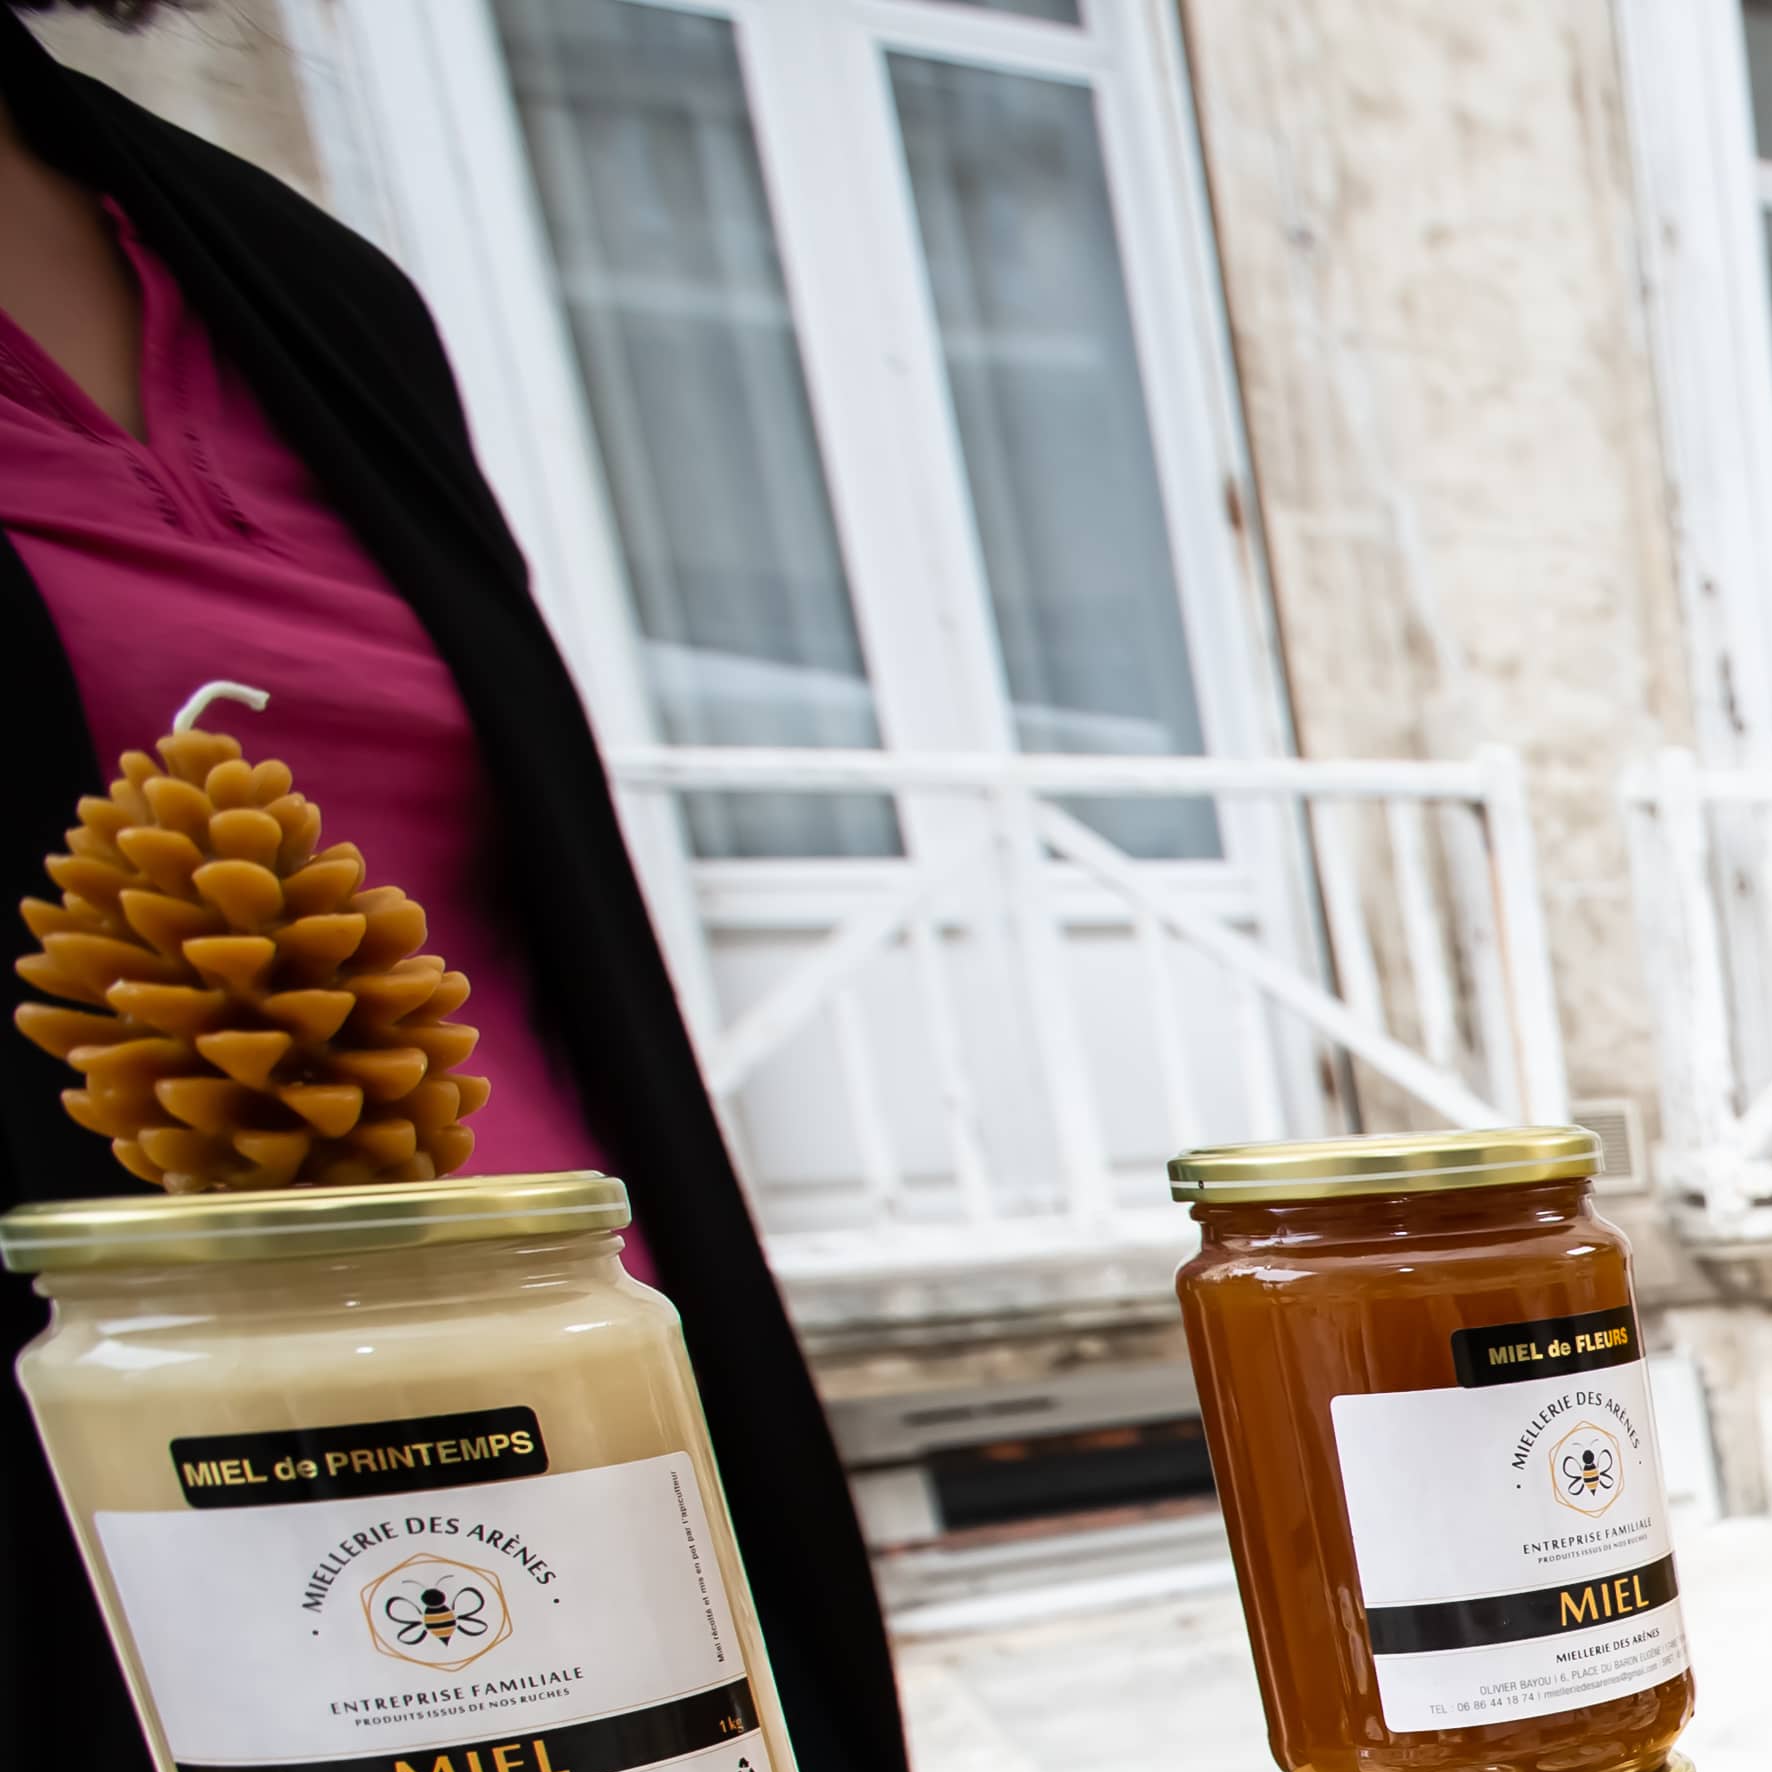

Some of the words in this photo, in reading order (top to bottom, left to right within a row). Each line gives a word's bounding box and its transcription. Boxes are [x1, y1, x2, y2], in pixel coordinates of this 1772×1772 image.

[1488, 1342, 1543, 1366] MIEL
[1548, 1340, 1571, 1358] de
[1576, 1327, 1628, 1353] FLEURS
[1512, 1395, 1572, 1470] MIELLERIE
[1576, 1391, 1602, 1406] DES
[182, 1458, 268, 1488] MIEL
[274, 1455, 318, 1481] de
[325, 1430, 535, 1476] PRINTEMPS
[302, 1521, 399, 1613] MIELLERIE
[405, 1516, 459, 1535] DES
[467, 1523, 557, 1586] ARÈNES
[1523, 1530, 1602, 1555] ENTREPRISE
[1560, 1575, 1650, 1627] MIEL
[1555, 1643, 1611, 1664] MIELLERIE
[1613, 1638, 1630, 1651] DES
[330, 1687, 464, 1716] ENTREPRISE
[471, 1666, 585, 1697] FAMILIALE
[354, 1709, 425, 1728] PRODUITS
[427, 1704, 466, 1719] ISSUS
[468, 1701, 485, 1715] DE
[488, 1696, 517, 1710] NOS
[520, 1687, 570, 1705] RUCHES
